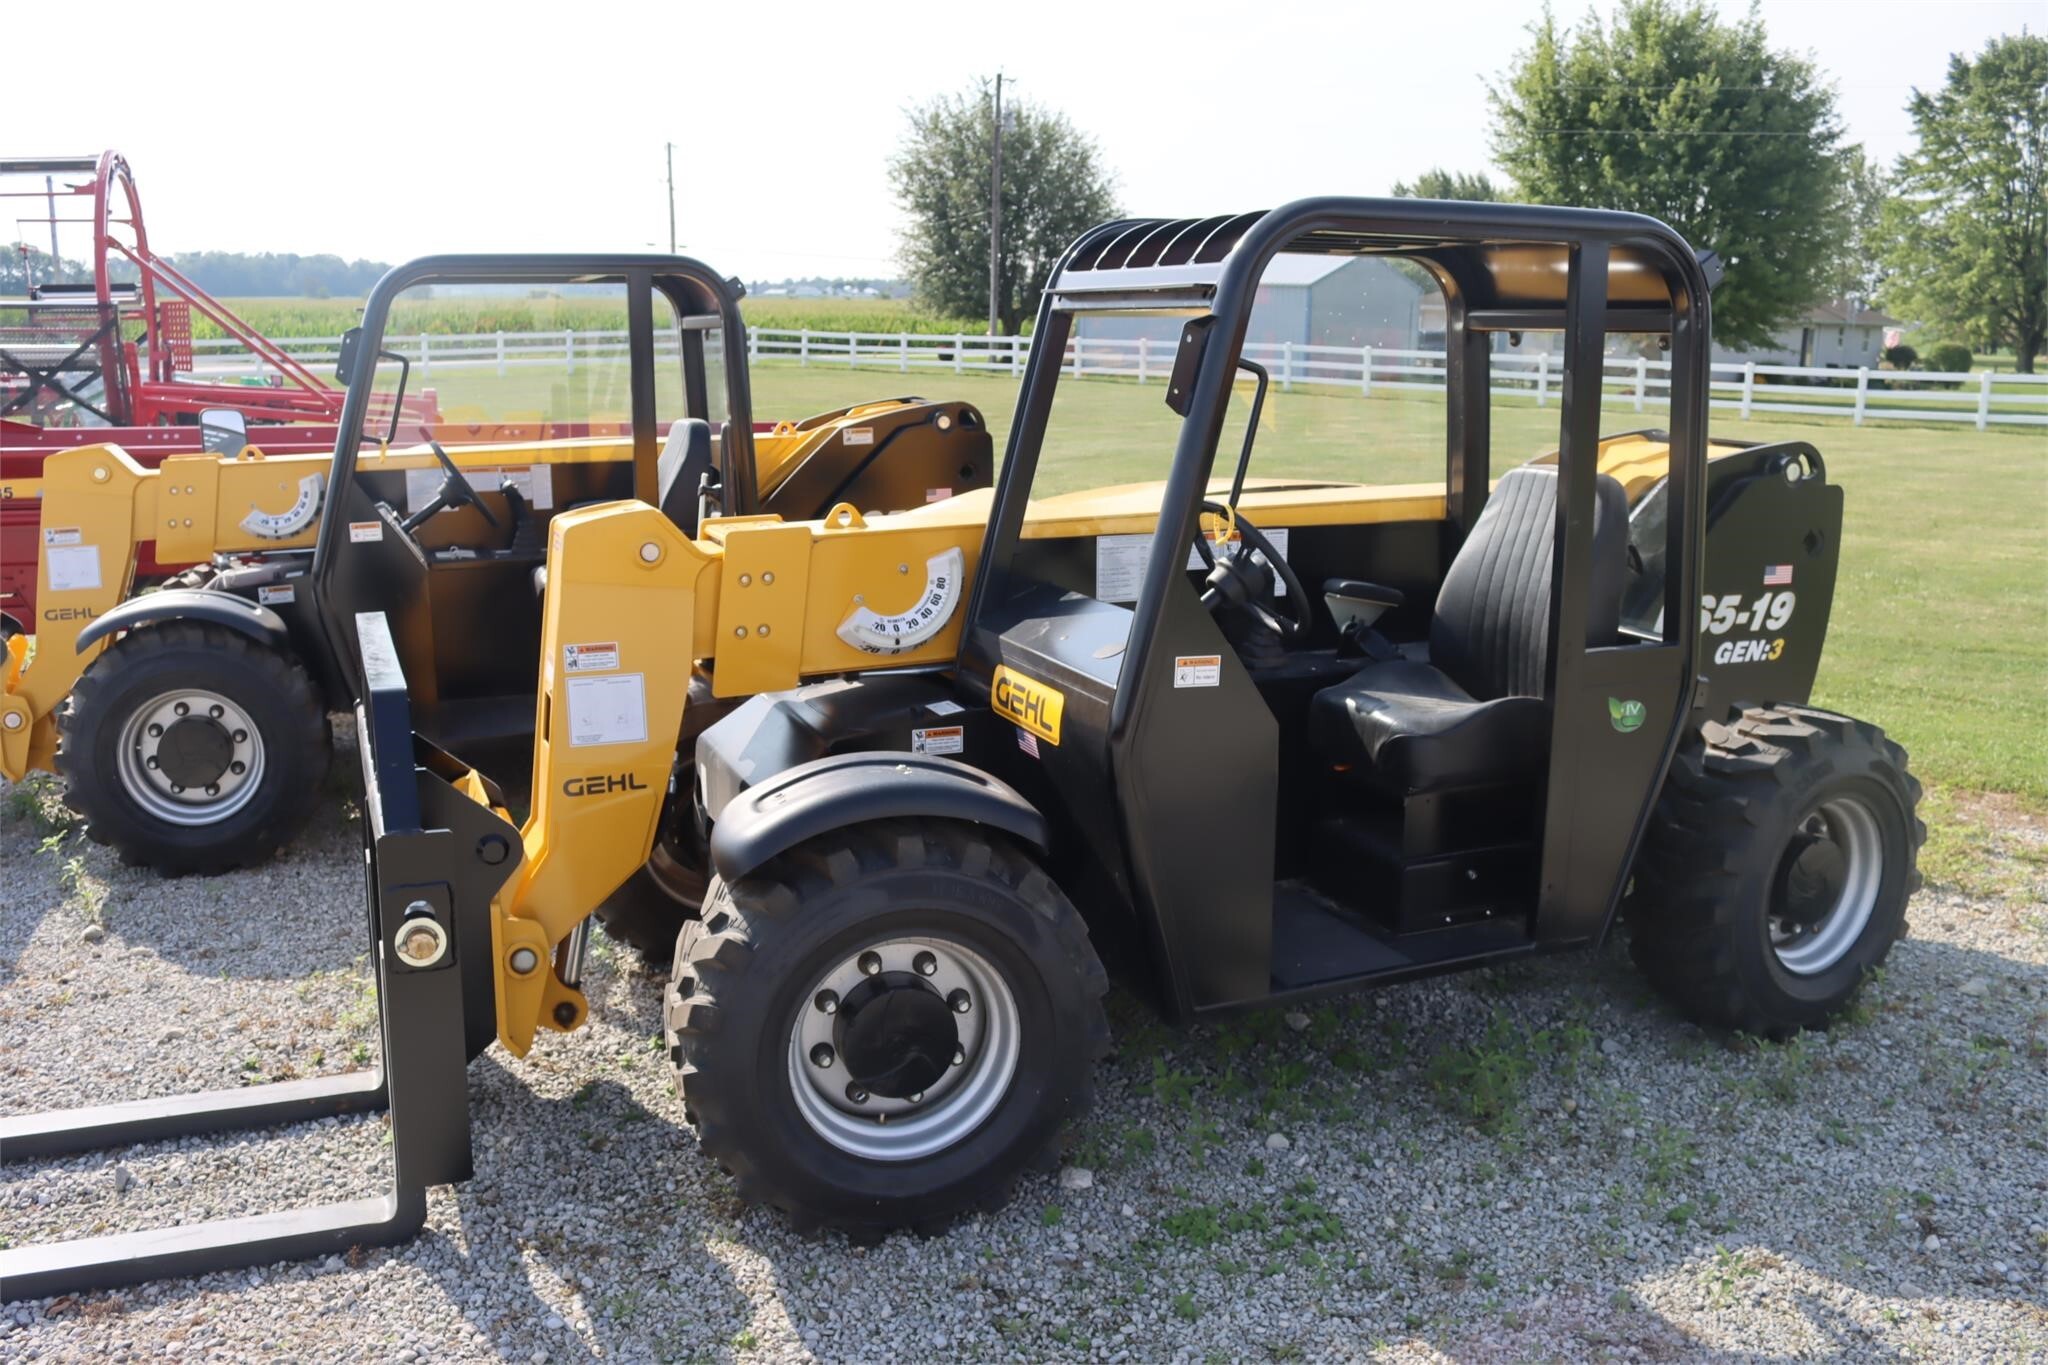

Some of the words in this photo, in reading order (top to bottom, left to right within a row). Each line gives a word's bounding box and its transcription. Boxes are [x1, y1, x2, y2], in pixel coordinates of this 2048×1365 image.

[0, 486, 14, 499] 5
[44, 608, 101, 621] GEHL
[893, 624, 900, 633] 0
[906, 618, 919, 629] 20
[920, 608, 933, 619] 40
[930, 593, 942, 606] 60
[936, 577, 946, 590] 80
[1700, 591, 1796, 635] S5-19
[1714, 638, 1785, 665] GEN:3
[996, 677, 1053, 732] GEHL
[1626, 703, 1641, 716] IV
[563, 772, 648, 798] GEHL
